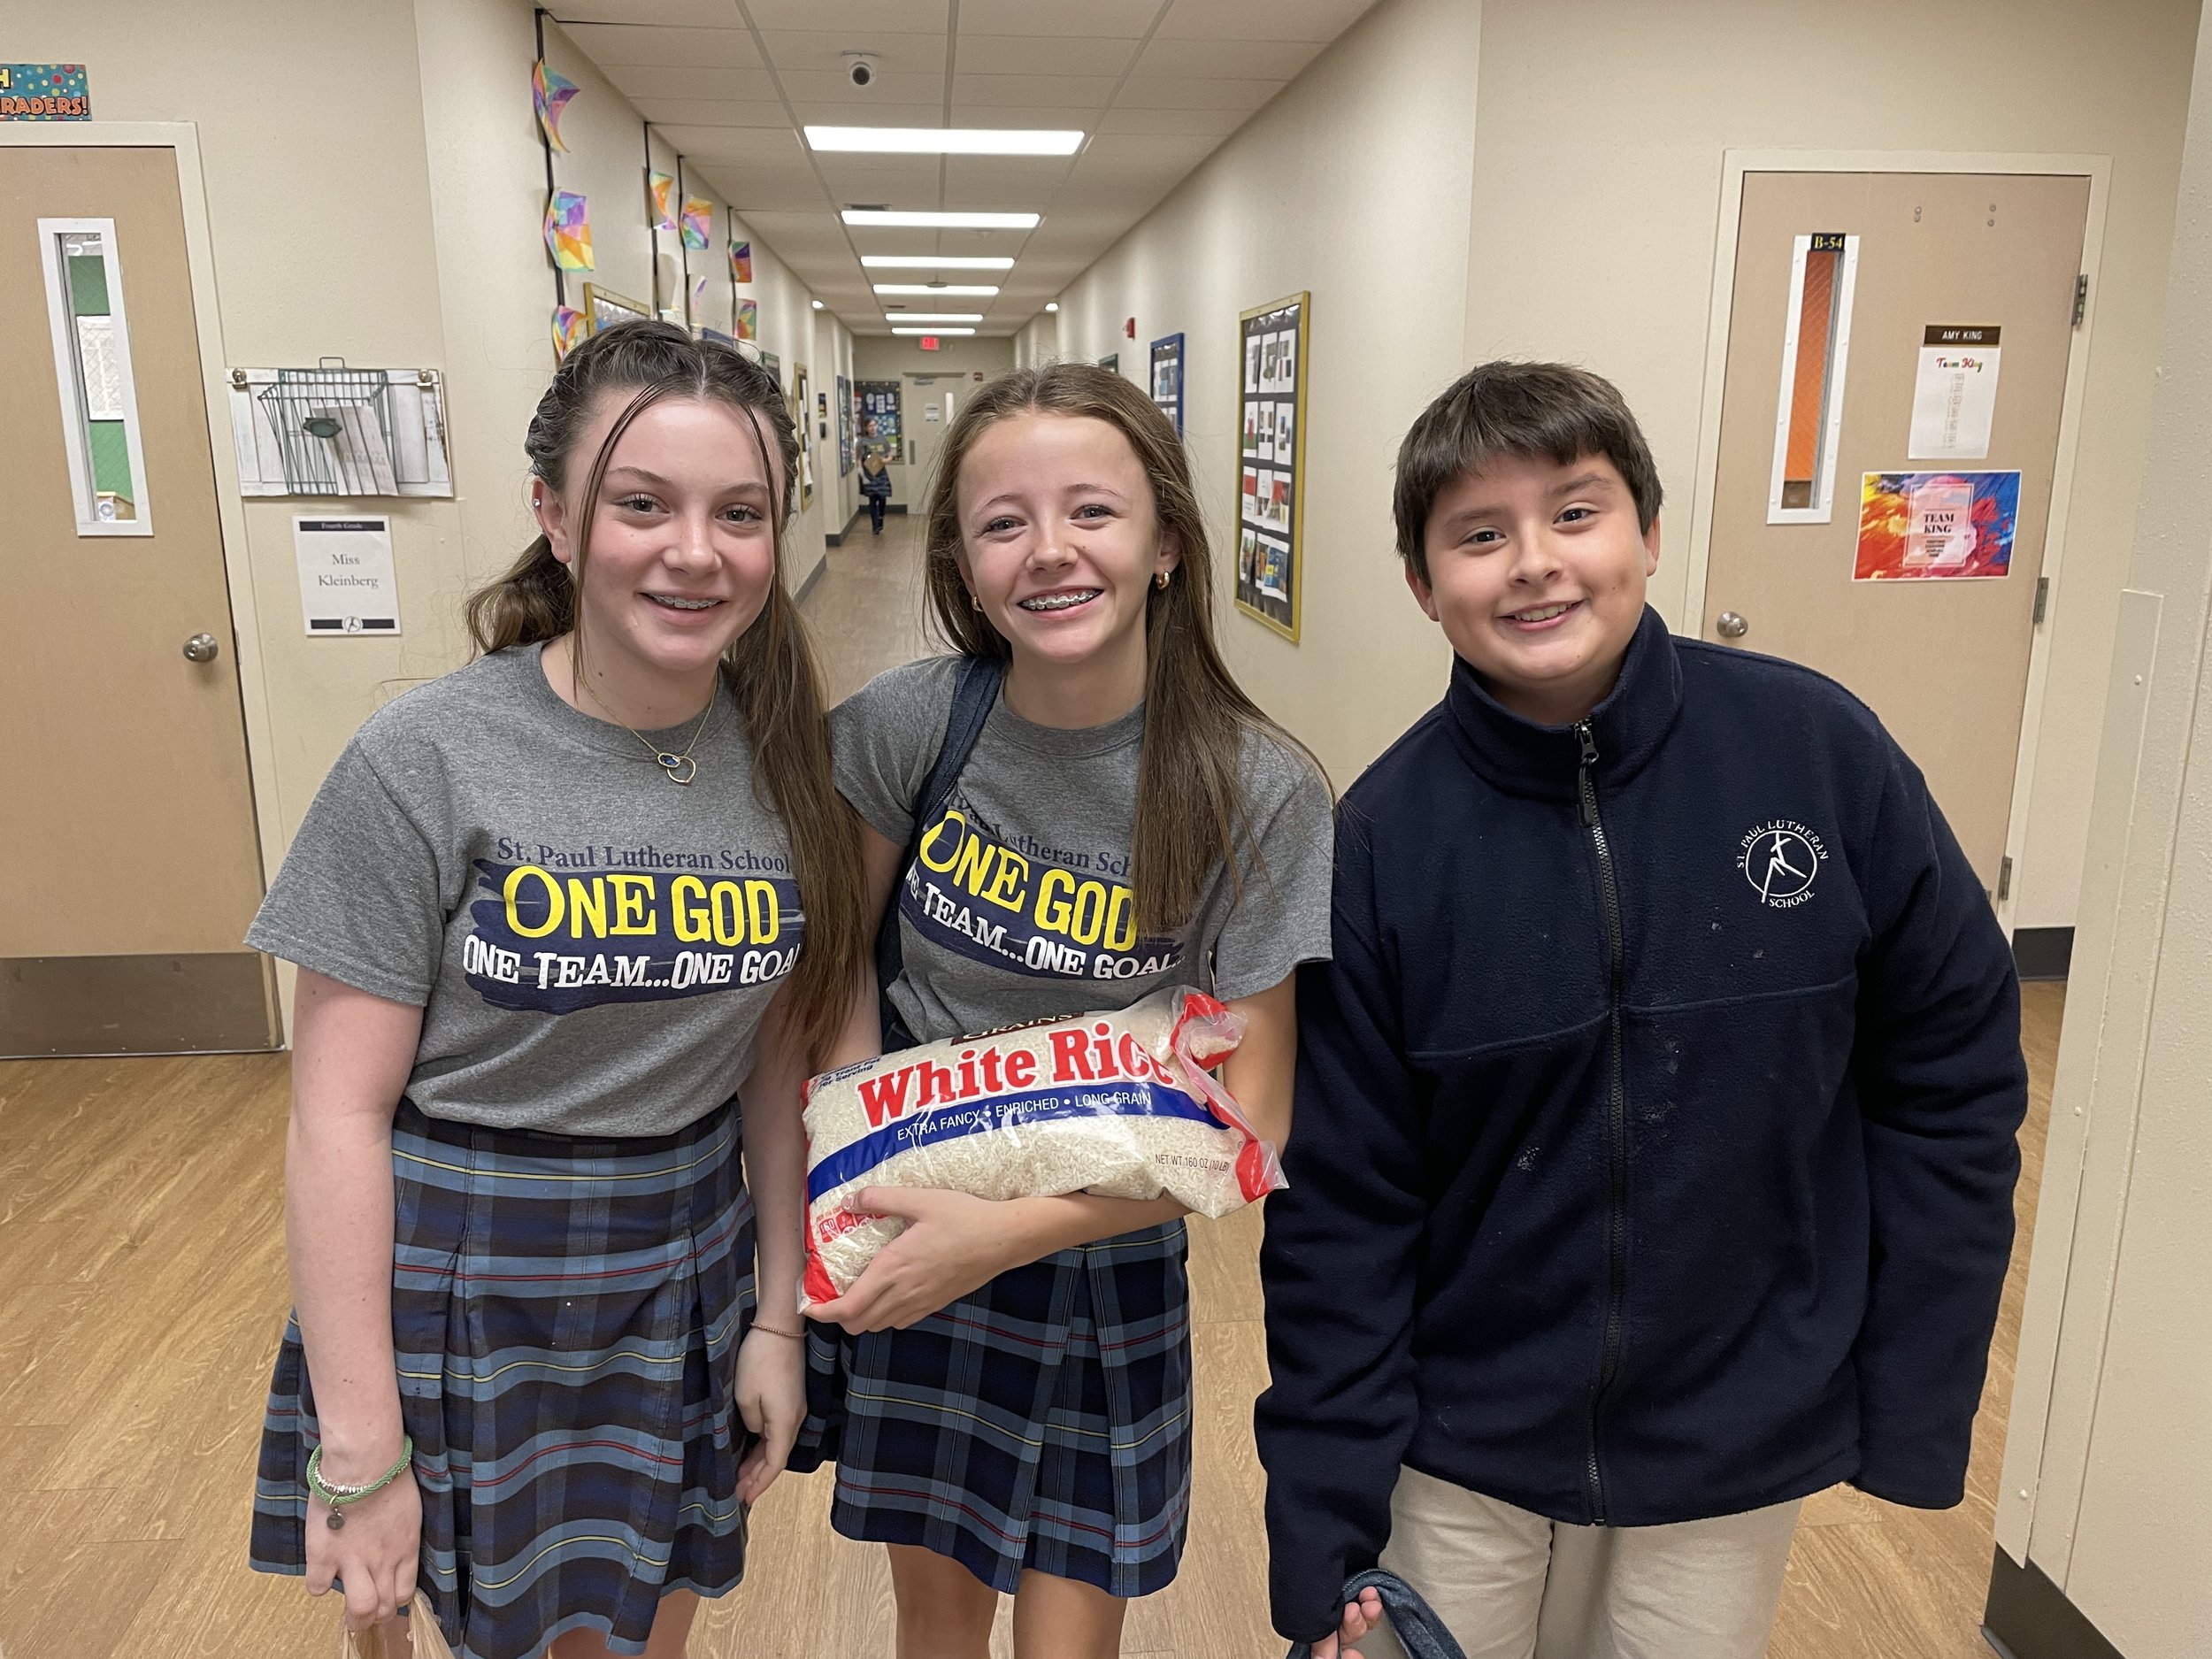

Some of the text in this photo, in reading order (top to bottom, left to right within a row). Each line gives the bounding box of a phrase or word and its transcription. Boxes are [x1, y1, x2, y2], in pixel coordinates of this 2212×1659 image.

[0, 96, 88, 115] RADERS!
[1815, 235, 1843, 249] B-54
[1942, 330, 1983, 341] AMY KING
[1924, 513, 1955, 523] TEAM
[1924, 524, 1952, 534] KING
[332, 554, 360, 565] Miss
[319, 574, 380, 589] Kleinberg
[1740, 826, 1765, 849] PAUL
[1768, 819, 1829, 860] LUTHERAN
[497, 837, 790, 874] St. Paul Lutheran School
[919, 810, 1029, 913] ONE
[1033, 868, 1138, 952] GOD
[503, 864, 780, 947] ONE GOD
[1769, 890, 1815, 908] SCHOOL
[462, 933, 521, 985] ONE
[835, 1064, 873, 1081] Serving
[857, 1046, 1036, 1128] White
[995, 1096, 1059, 1118] ENRICHED
[1075, 1091, 1152, 1108] LONG GRAIN
[897, 1109, 980, 1141] EXTRA FANCY
[1155, 1154, 1169, 1164] NET
[1171, 1155, 1183, 1165] WT
[1184, 1156, 1197, 1168] 160
[1199, 1157, 1209, 1169] OZ
